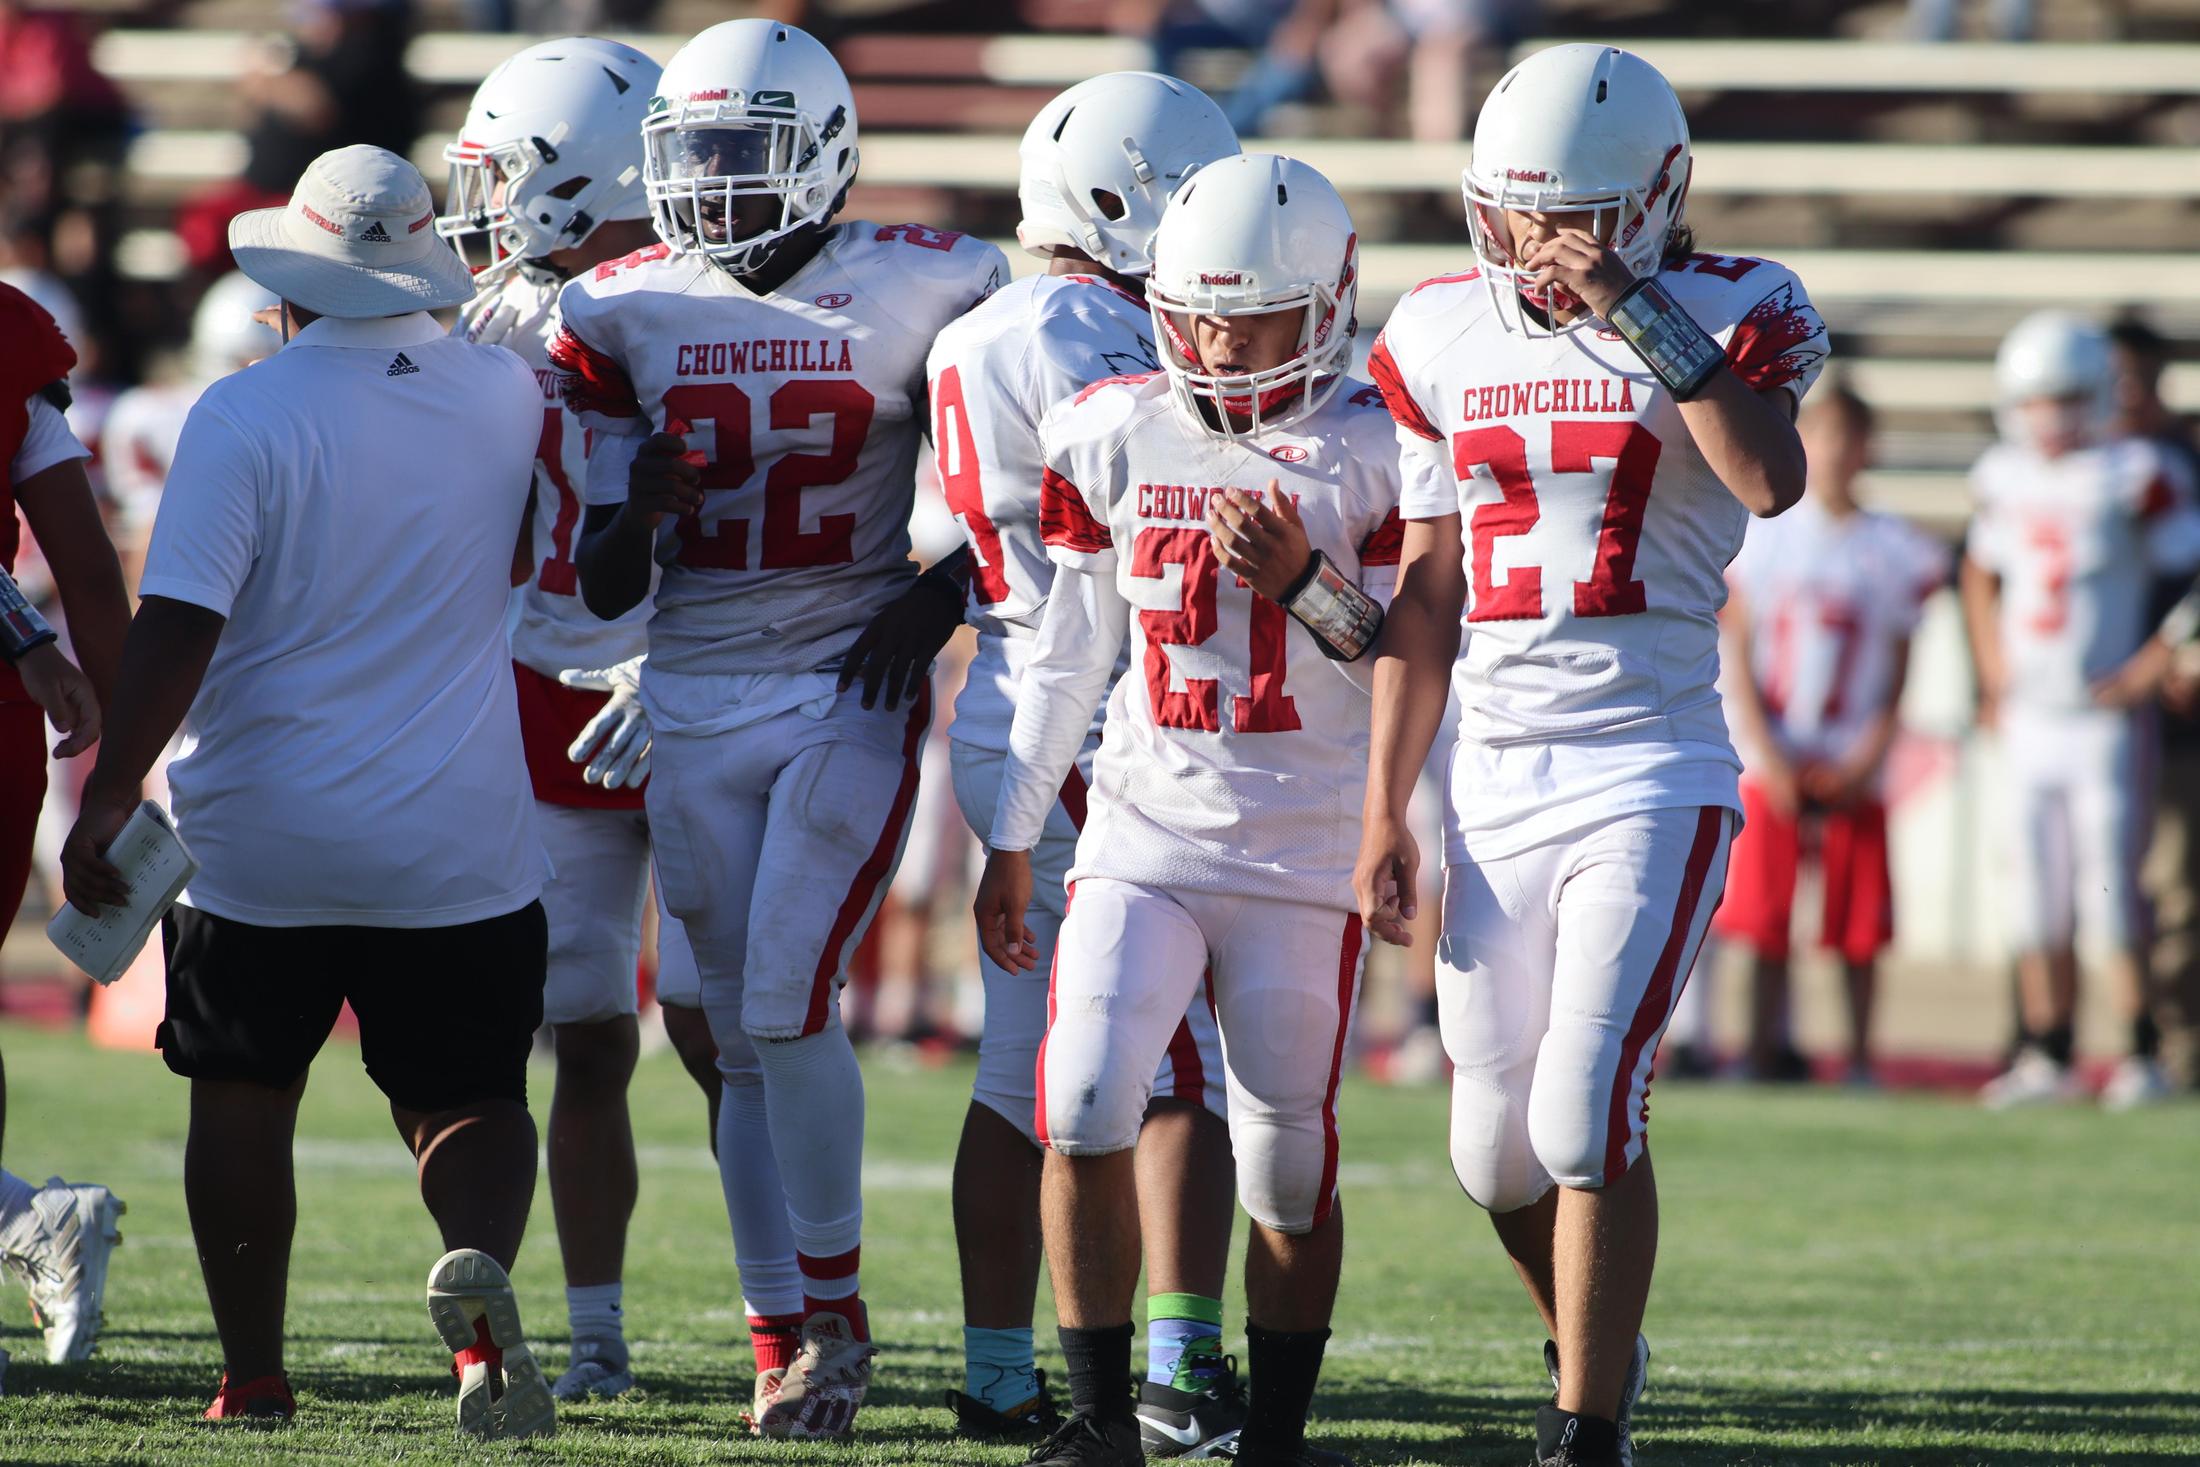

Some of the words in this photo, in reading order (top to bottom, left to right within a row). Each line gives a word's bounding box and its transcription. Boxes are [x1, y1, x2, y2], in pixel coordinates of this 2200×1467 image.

[1507, 168, 1547, 183] Riddell
[1200, 273, 1241, 286] Riddell
[1159, 310, 1187, 353] Riddell
[677, 339, 852, 377] CHOWCHILLA
[1463, 378, 1636, 422] CHOWCHILLA
[661, 379, 876, 571] 22
[1453, 420, 1662, 623] 27
[1130, 526, 1302, 734] 21
